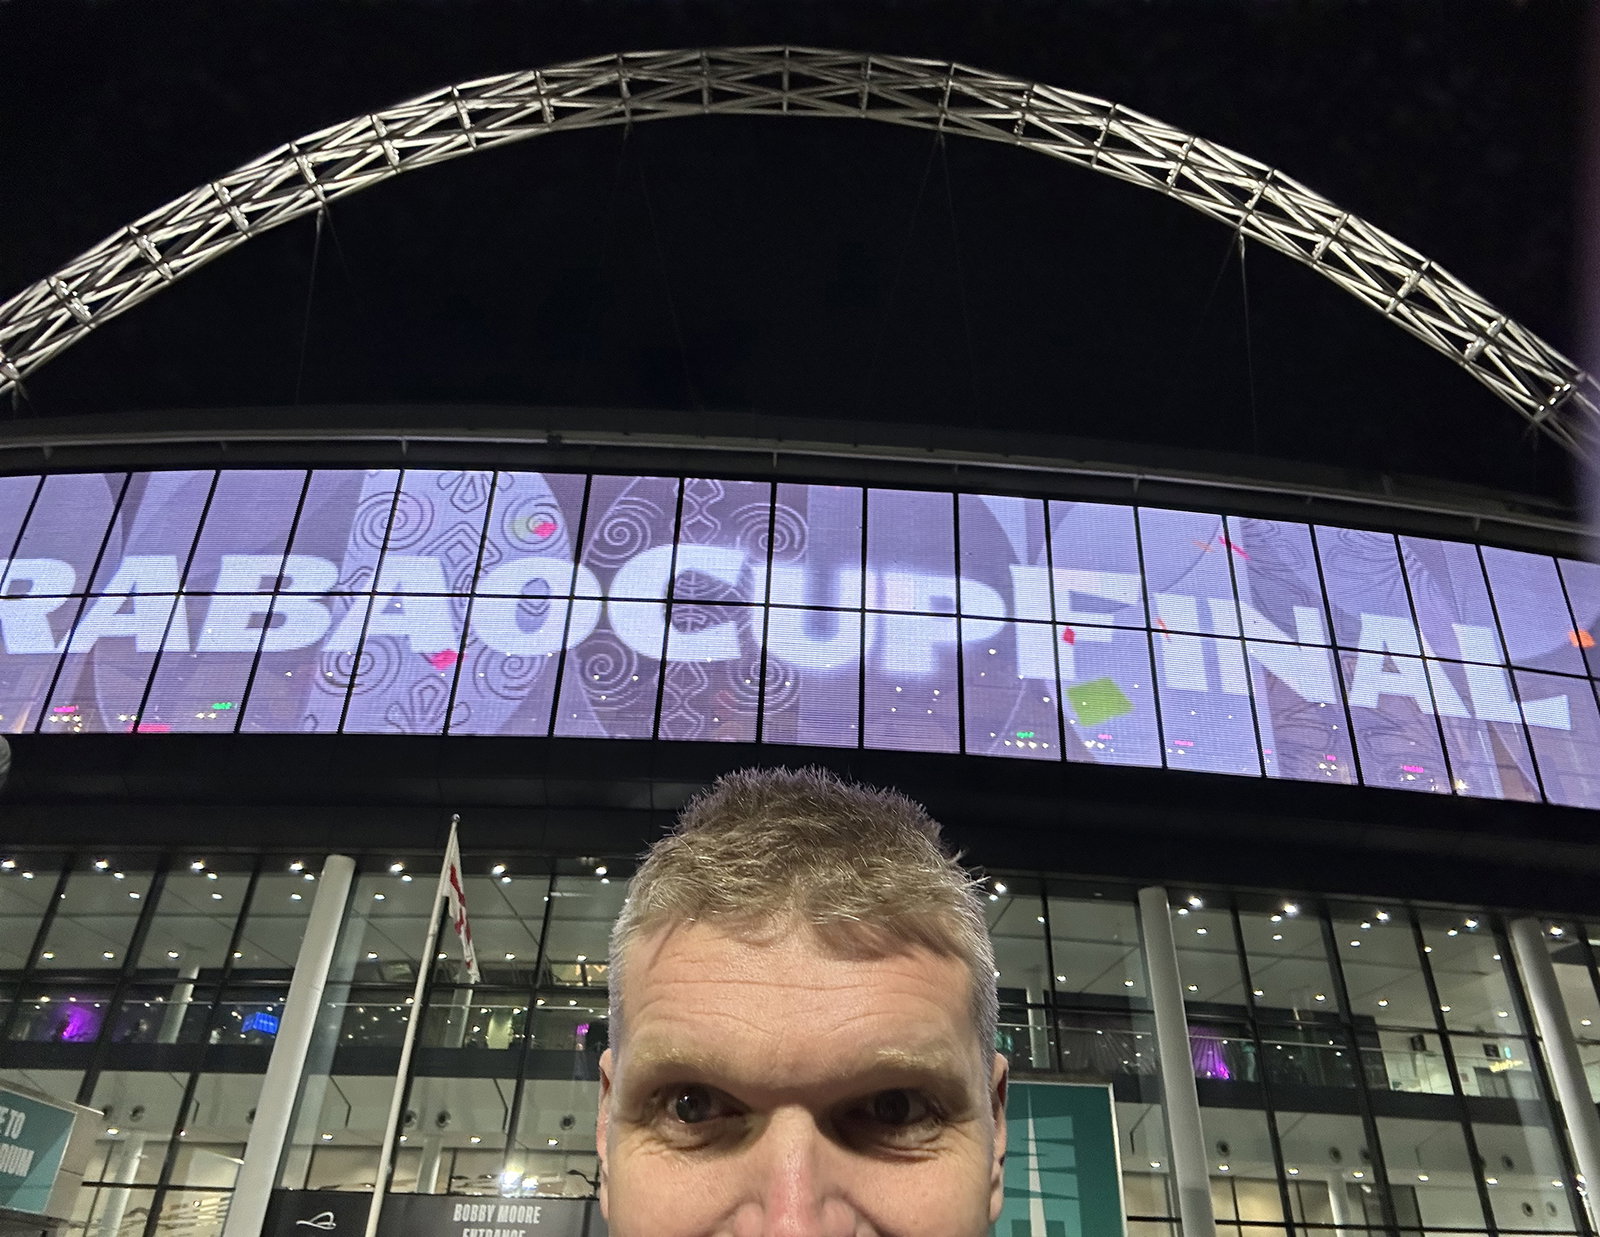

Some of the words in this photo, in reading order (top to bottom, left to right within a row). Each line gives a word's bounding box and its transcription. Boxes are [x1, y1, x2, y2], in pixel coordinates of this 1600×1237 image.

[607, 543, 1006, 674] CUP
[1008, 565, 1571, 731] FINAL
[5, 1109, 26, 1139] TO
[453, 1203, 496, 1222] BOBBY
[497, 1205, 541, 1224] MOORE
